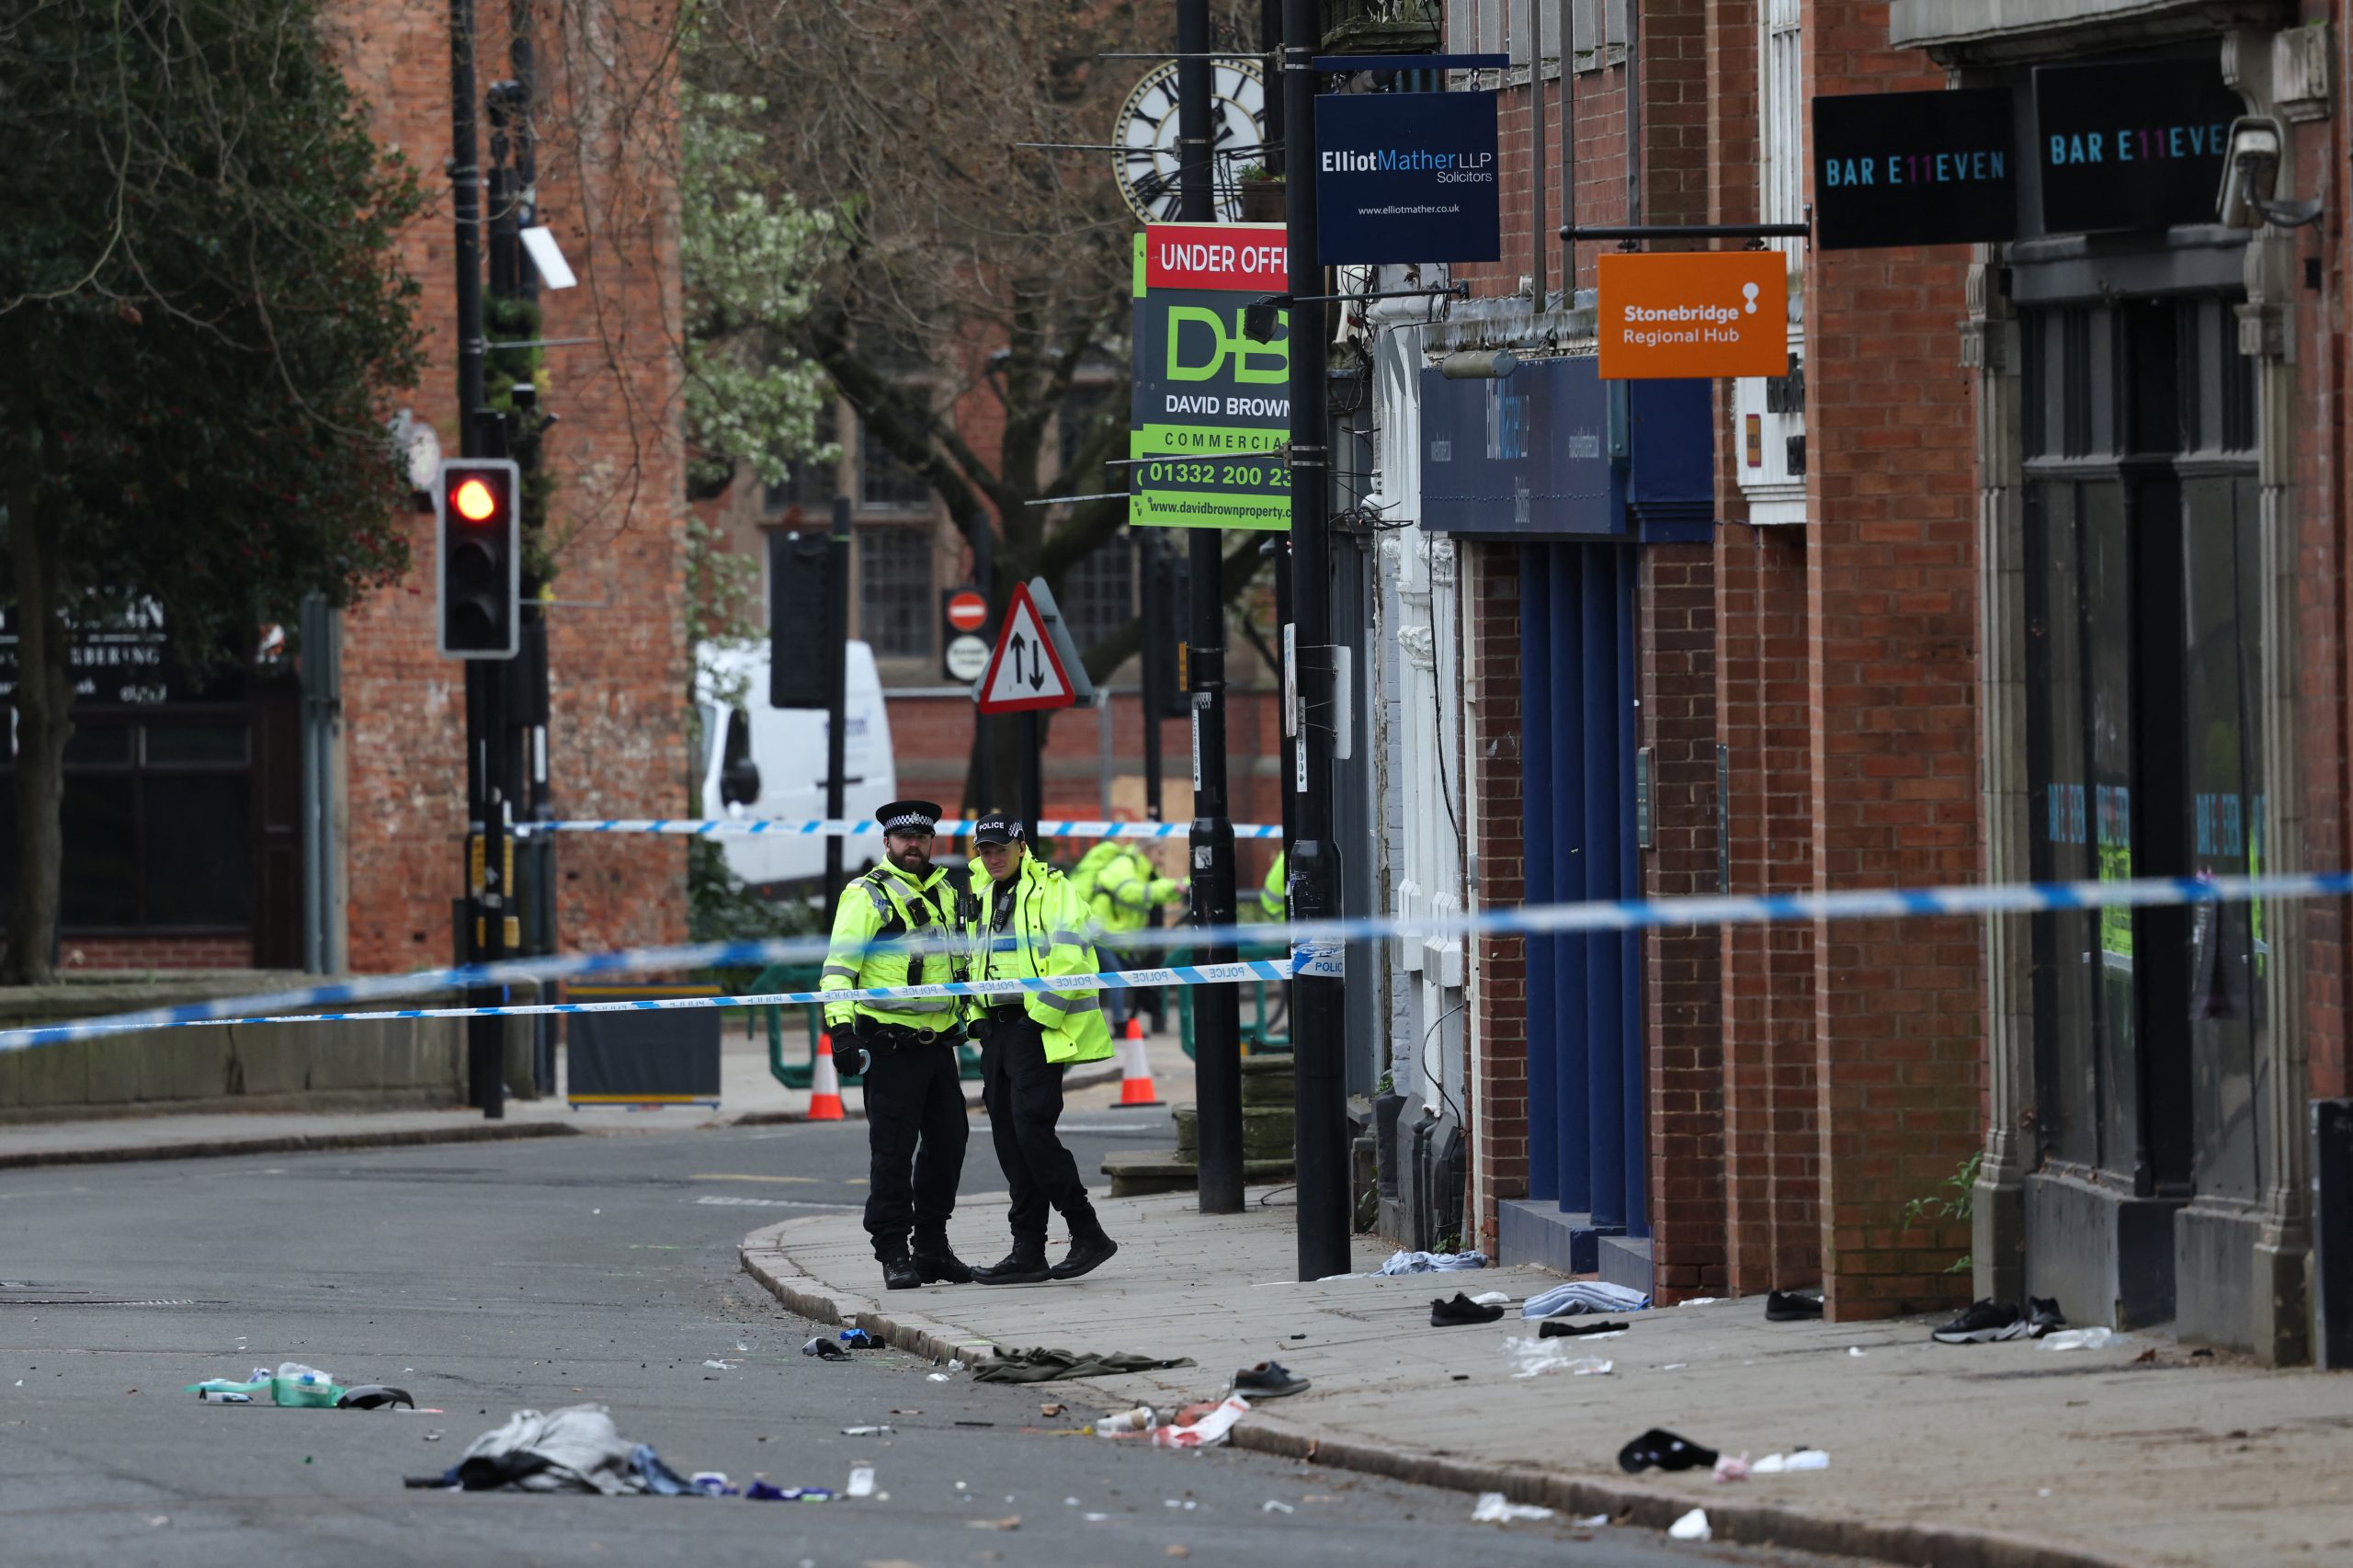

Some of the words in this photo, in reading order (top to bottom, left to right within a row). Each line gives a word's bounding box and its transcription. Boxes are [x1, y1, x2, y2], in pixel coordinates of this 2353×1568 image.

[2050, 134, 2103, 165] BAR
[2118, 124, 2224, 161] E11EVE
[1322, 149, 1456, 172] ElliotMather
[1459, 153, 1492, 169] LLP
[1437, 171, 1493, 184] Solicitors
[1826, 158, 1874, 187] BAR
[1358, 204, 1460, 215] www.elliotmather.co.uk
[1161, 244, 1235, 272] UNDER
[1241, 246, 1288, 274] OFF
[1624, 305, 1740, 324] Stonebridge
[1623, 328, 1699, 347] Regional
[1704, 327, 1740, 342] Hub
[1165, 394, 1220, 414] DAVID
[1165, 432, 1283, 450] COMMERCIA
[1150, 462, 1215, 483] 01332
[1222, 466, 1262, 486] 200
[1269, 468, 1291, 487] 23
[1150, 501, 1291, 520] www.davidbrownproperty.c
[979, 822, 1005, 832] POLICE
[1314, 961, 1343, 973] POLIC
